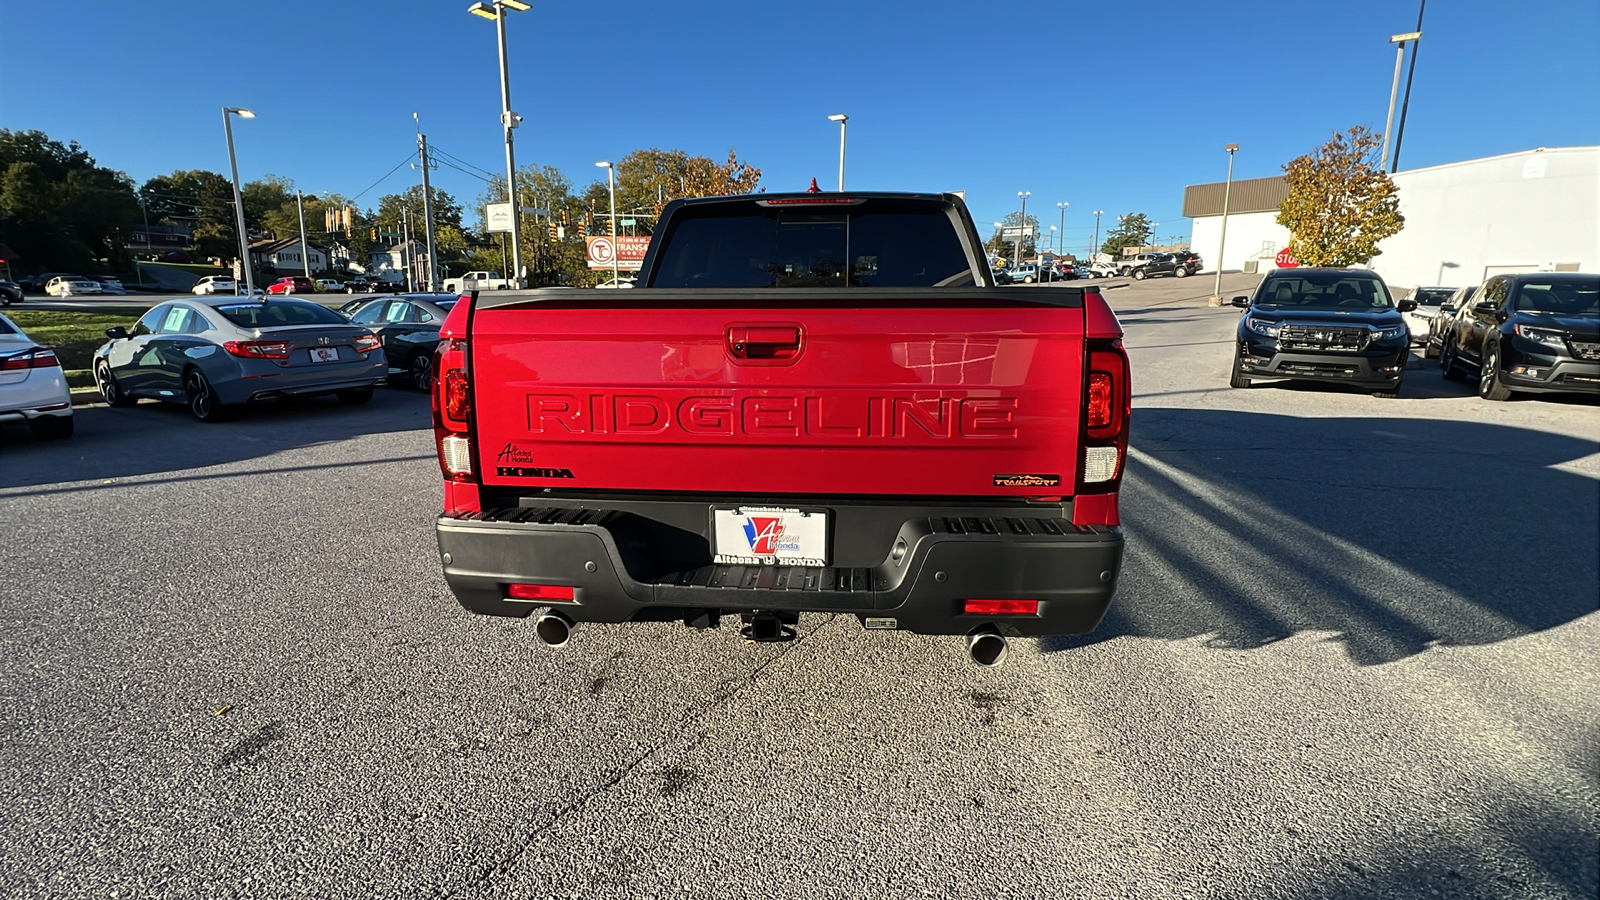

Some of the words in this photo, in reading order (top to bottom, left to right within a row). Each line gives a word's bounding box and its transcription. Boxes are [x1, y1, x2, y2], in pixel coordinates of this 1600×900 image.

[526, 393, 1018, 439] RIDGELINE
[496, 466, 576, 479] HONDA
[738, 505, 800, 513] altoonahonda.com
[771, 541, 799, 550] Honda
[713, 554, 760, 564] Altoona
[778, 558, 825, 567] HONDA
